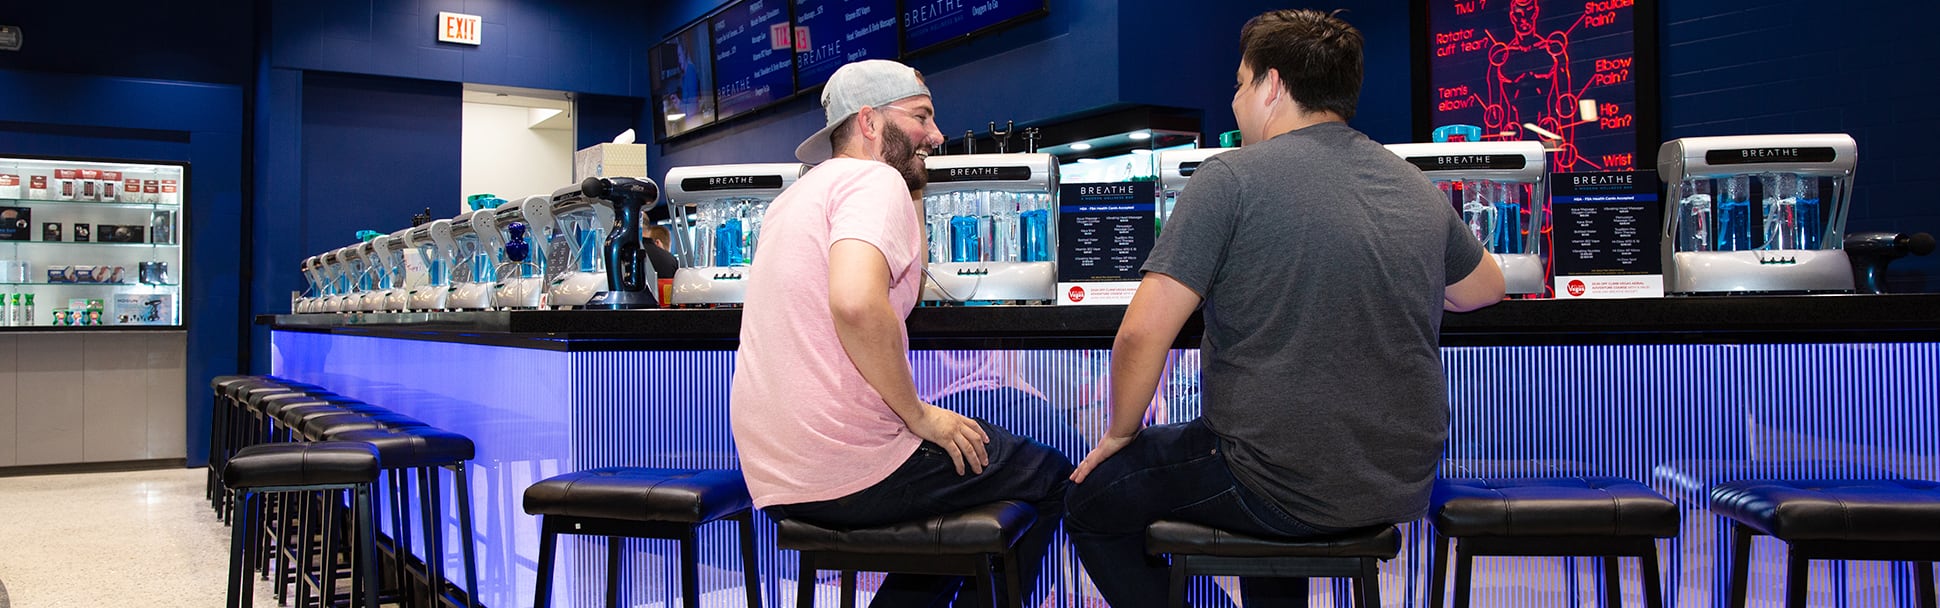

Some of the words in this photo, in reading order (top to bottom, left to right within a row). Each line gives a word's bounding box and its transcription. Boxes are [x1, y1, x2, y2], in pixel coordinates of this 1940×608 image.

[904, 0, 963, 27] BREATHE
[1455, 0, 1475, 15] TMJ
[1585, 11, 1616, 28] Pain?
[447, 16, 476, 40] EXIT
[1436, 29, 1474, 45] Rotator
[797, 39, 841, 68] BREATHE
[1437, 43, 1456, 57] cuff
[1461, 37, 1488, 52] tear?
[1595, 57, 1632, 73] Elbow
[1596, 70, 1629, 86] Pain?
[716, 76, 751, 99] BREATHE
[1438, 85, 1469, 100] Tennis
[1438, 93, 1475, 112] elbow?
[1600, 103, 1619, 117] Hip
[1600, 115, 1633, 130] Pain?
[1438, 155, 1491, 165] BREATHE
[1602, 152, 1632, 167] Wrist
[1741, 148, 1798, 158] BREATHE
[950, 167, 999, 176] BREATHE
[709, 176, 754, 185] BREATHE
[1573, 174, 1633, 185] BREATHE
[1080, 185, 1134, 195] BREATHE
